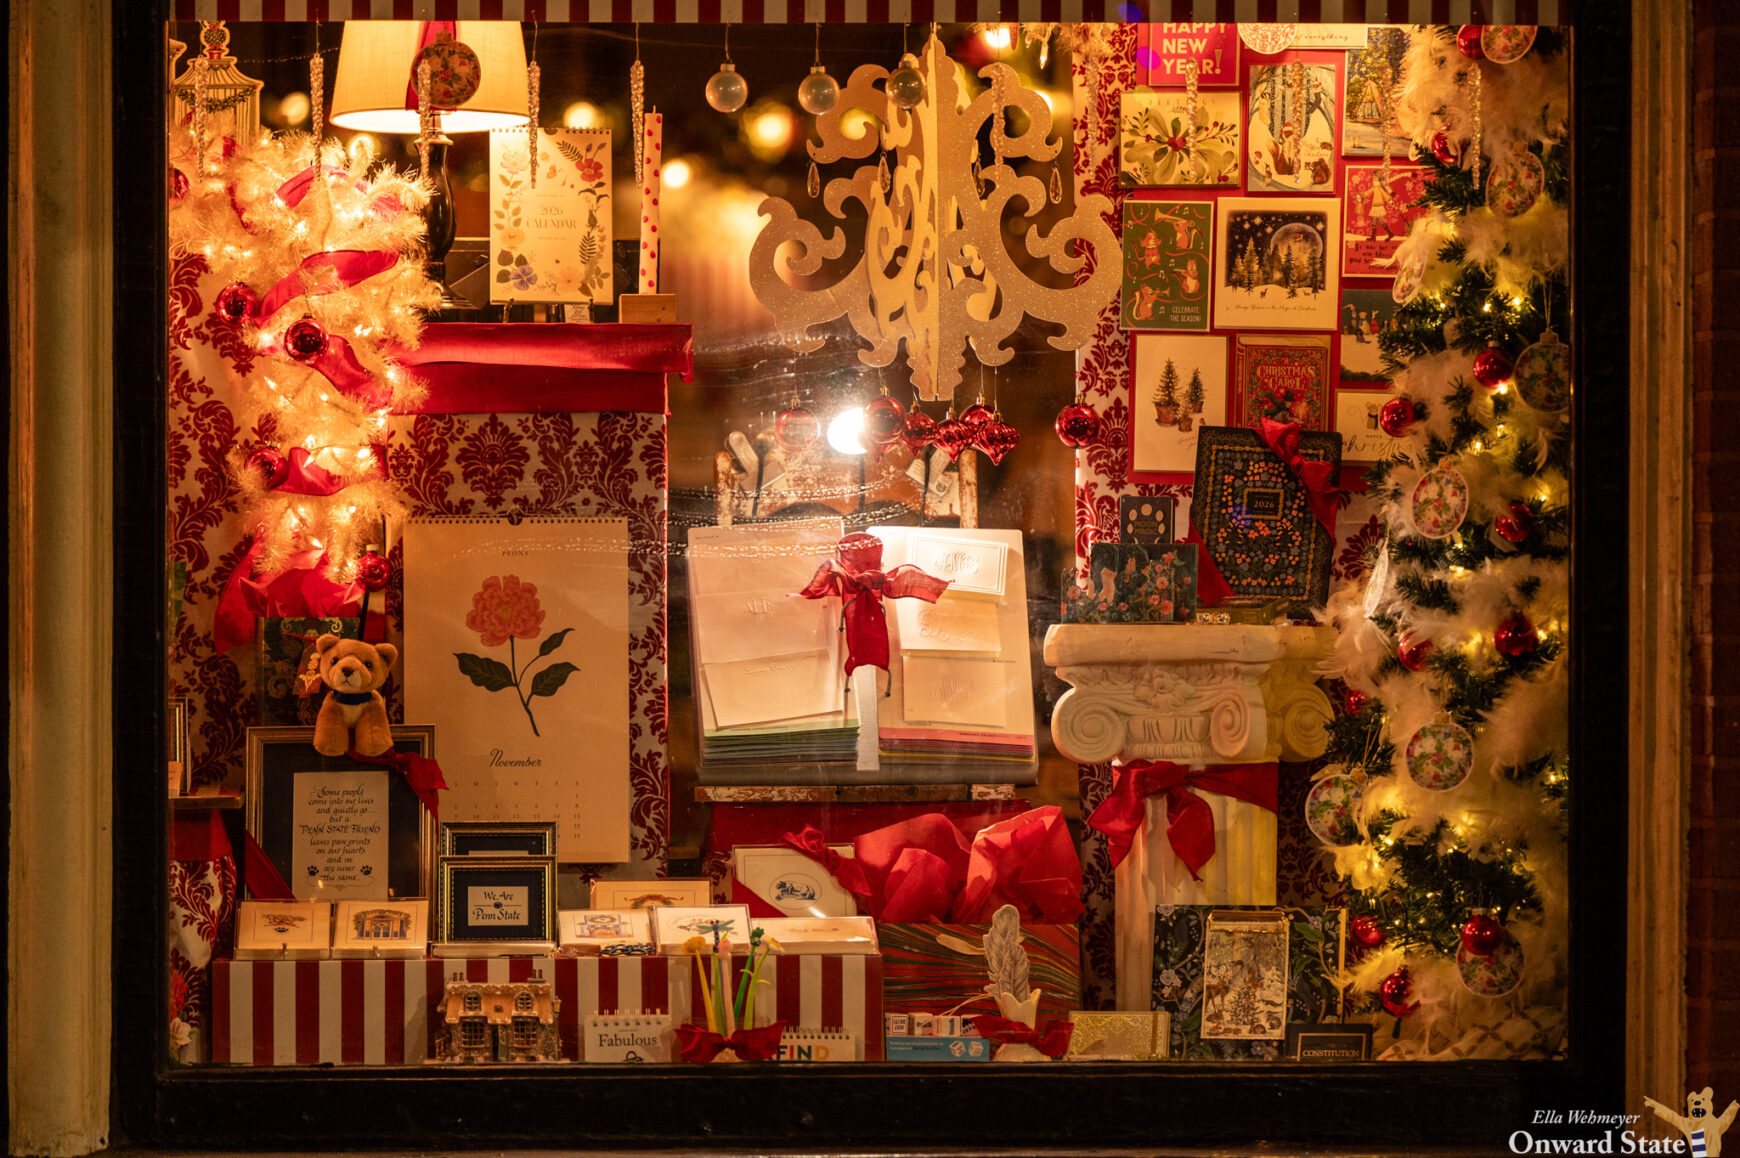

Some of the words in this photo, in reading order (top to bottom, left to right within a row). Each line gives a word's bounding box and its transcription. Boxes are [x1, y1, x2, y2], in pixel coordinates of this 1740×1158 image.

[1163, 23, 1225, 34] HAPPY
[1162, 38, 1207, 54] NEW
[540, 205, 564, 216] 2026
[526, 218, 577, 229] CALENDAR
[1171, 305, 1200, 314] CELEBRATE
[1256, 365, 1316, 378] CHRISTMAS
[1269, 376, 1305, 390] CAROL
[1253, 500, 1276, 509] 2026
[489, 748, 543, 768] November
[312, 786, 341, 799] Some
[341, 783, 366, 799] people
[329, 797, 344, 807] into
[357, 796, 375, 806] lives
[316, 806, 331, 815] and
[333, 805, 358, 817] quietly
[329, 815, 343, 823] but
[298, 822, 326, 834] PENN
[326, 823, 349, 834] STATE
[350, 821, 381, 834] FRIEND
[310, 835, 330, 846] leaves
[331, 839, 347, 848] paw
[347, 838, 371, 848] prints
[316, 847, 326, 855] on
[341, 846, 367, 856] hearts
[323, 865, 335, 873] are
[483, 891, 497, 901] We
[498, 891, 514, 901] Are
[472, 907, 497, 921] Penn
[497, 908, 521, 921] State
[599, 1033, 657, 1047] Fabulous
[776, 1045, 830, 1061] FIND
[1302, 1049, 1360, 1057] CONSTITUTION
